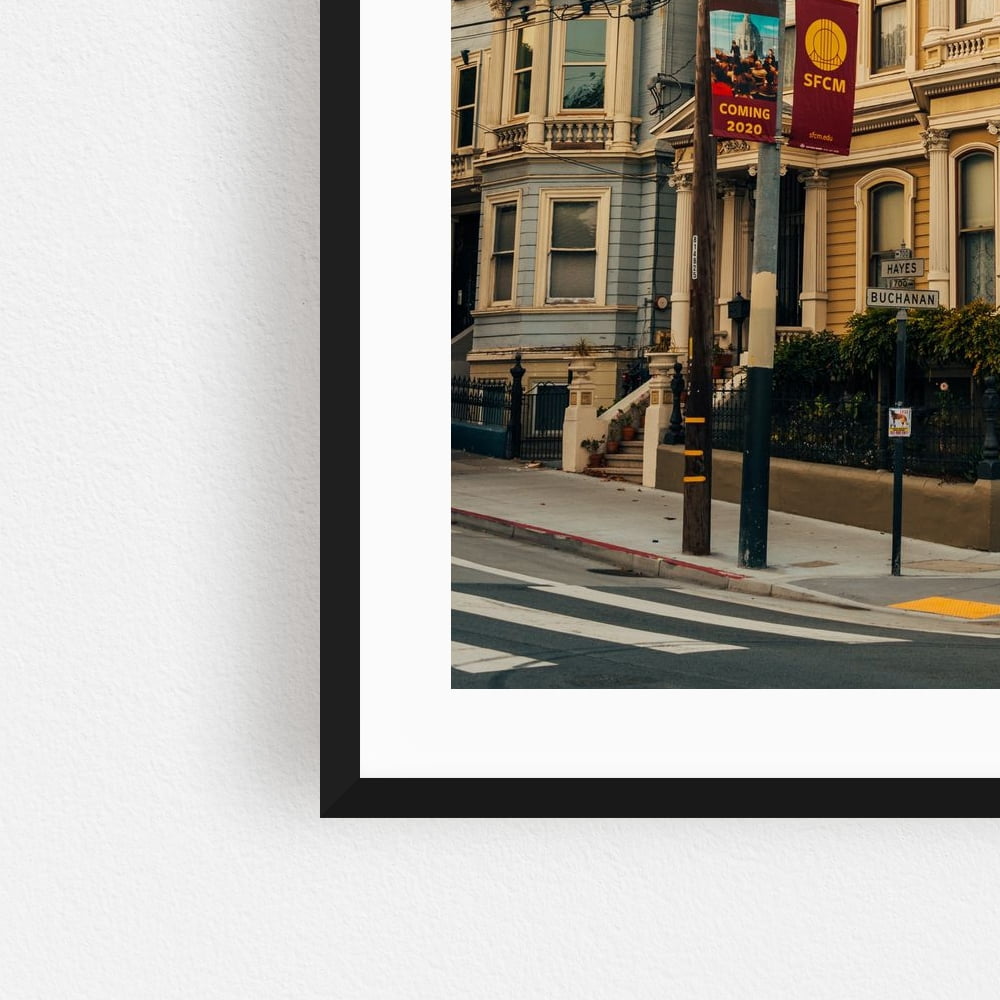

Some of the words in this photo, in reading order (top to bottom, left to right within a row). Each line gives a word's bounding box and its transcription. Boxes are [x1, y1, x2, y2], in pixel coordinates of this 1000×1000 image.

[803, 73, 846, 93] SFCM
[719, 103, 771, 120] COMING
[727, 121, 762, 135] 2020
[809, 131, 834, 142] sfcm.edu
[887, 262, 917, 274] HAYES
[871, 292, 935, 305] BUCHANAN
